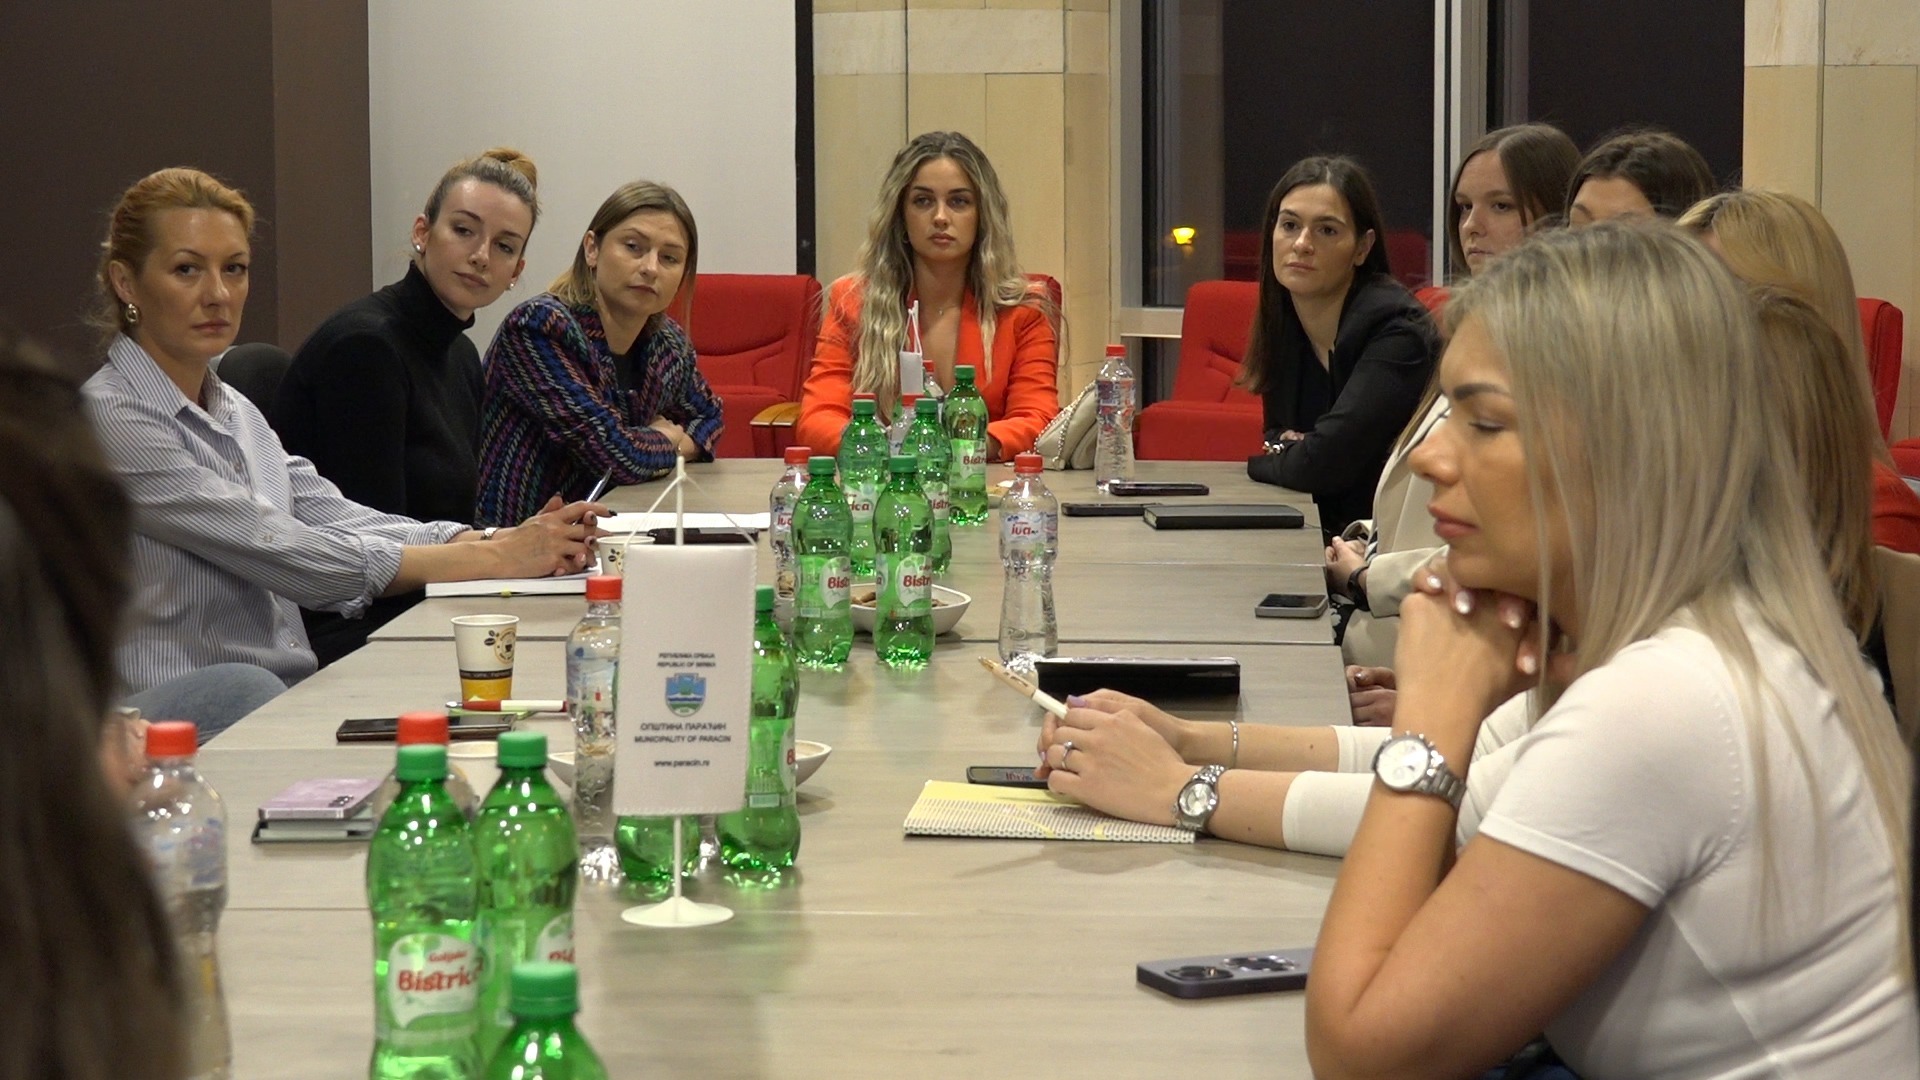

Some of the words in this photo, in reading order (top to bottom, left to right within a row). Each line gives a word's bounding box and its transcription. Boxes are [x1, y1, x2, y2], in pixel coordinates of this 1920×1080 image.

[640, 722, 682, 731] ОПШТИНА
[634, 735, 686, 743] MUNICIPALITY
[687, 735, 697, 743] OF
